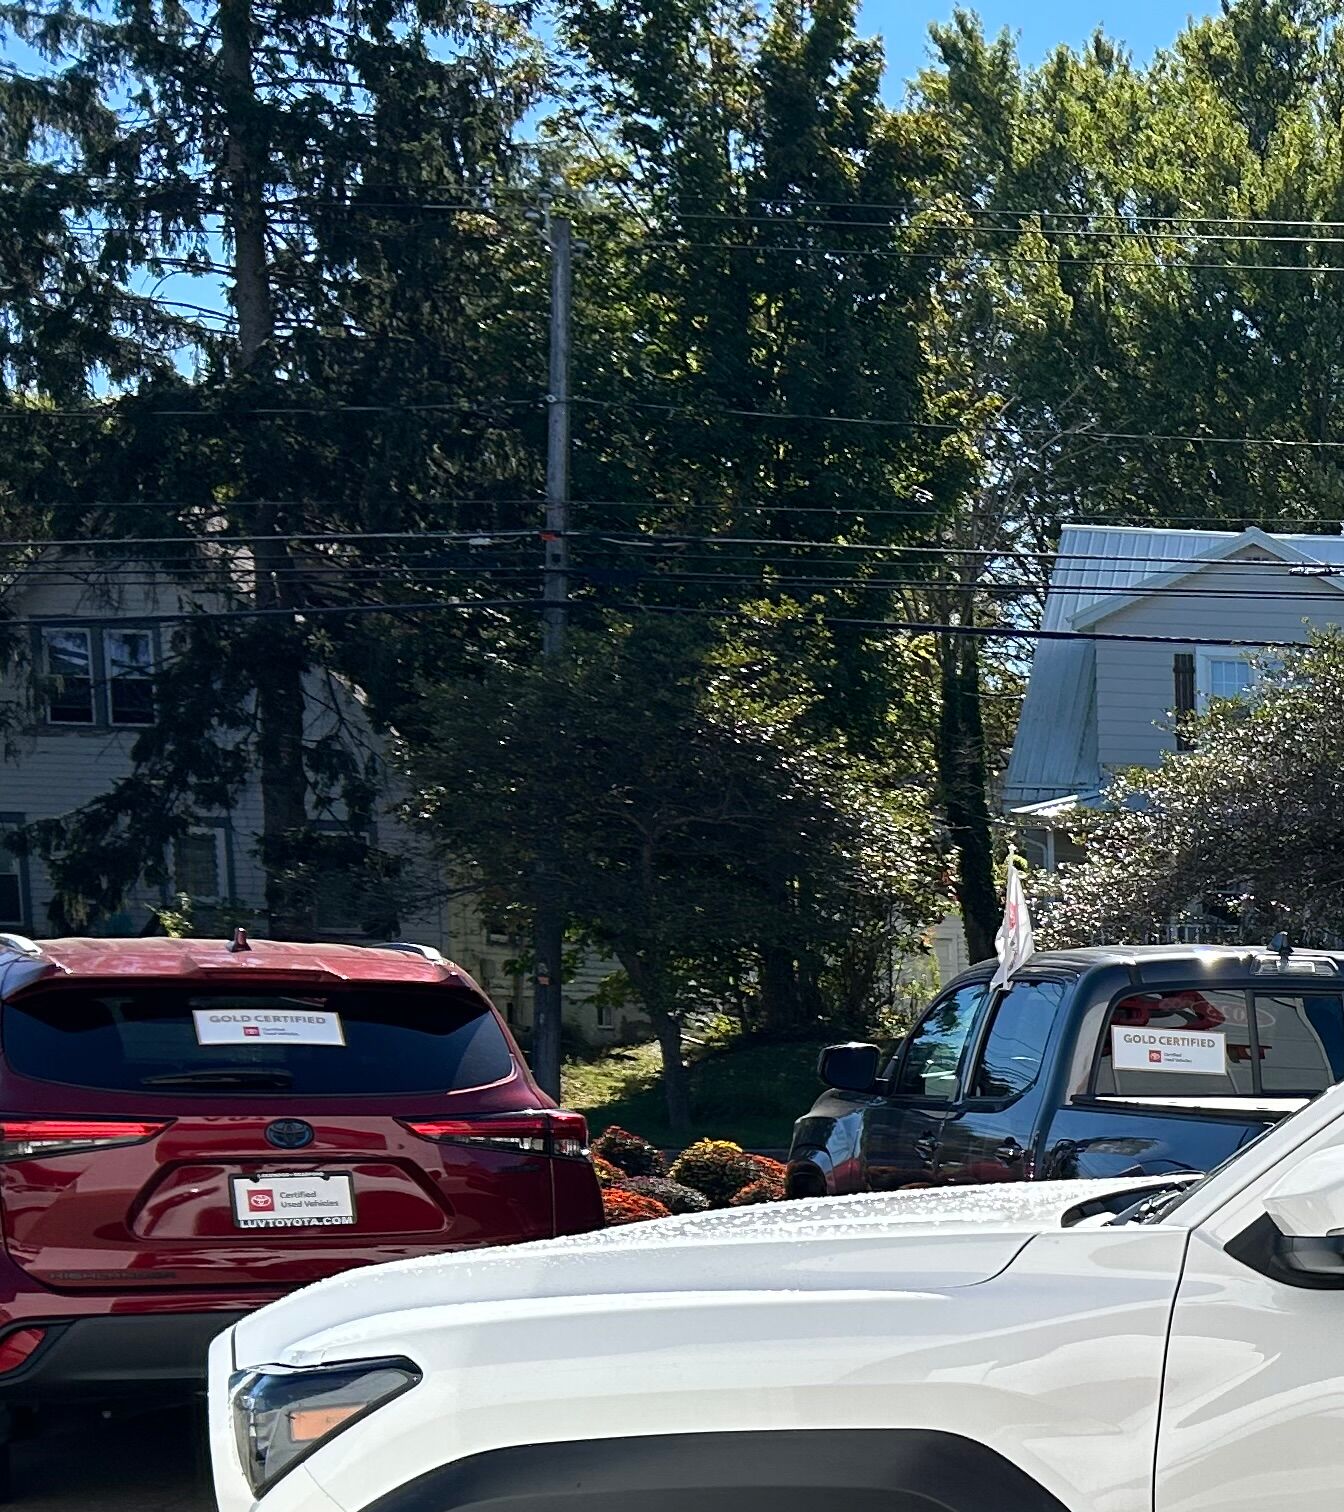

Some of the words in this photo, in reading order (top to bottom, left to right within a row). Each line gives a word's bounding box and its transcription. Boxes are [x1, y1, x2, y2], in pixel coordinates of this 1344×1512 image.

[209, 1015, 250, 1023] GOLD
[254, 1015, 326, 1024] CERTIFIED
[1123, 1034, 1156, 1045] GOLD
[1158, 1036, 1216, 1048] CERTIFIED
[280, 1191, 316, 1199] Certified
[240, 1217, 353, 1228] LUVTOYOTA.COM
